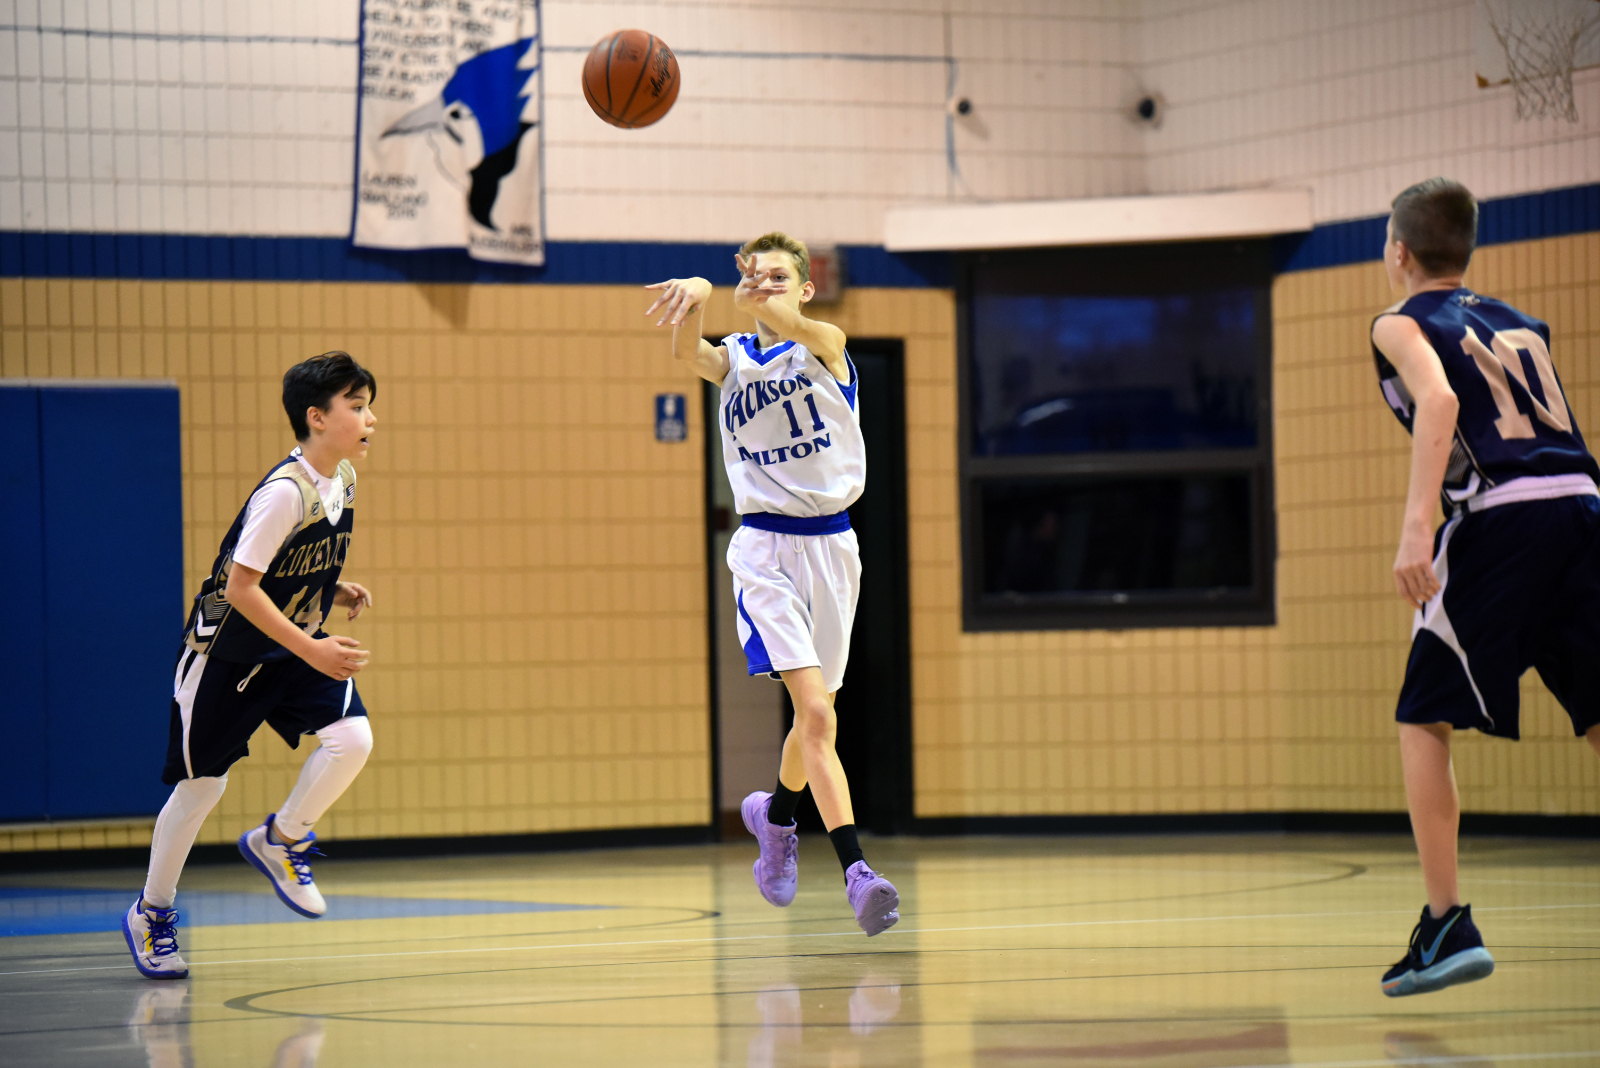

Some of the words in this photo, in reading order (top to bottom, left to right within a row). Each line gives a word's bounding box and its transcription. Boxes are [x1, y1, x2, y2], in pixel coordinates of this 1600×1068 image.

[1460, 325, 1573, 440] 10
[782, 393, 825, 438] 11
[282, 586, 323, 638] 14
